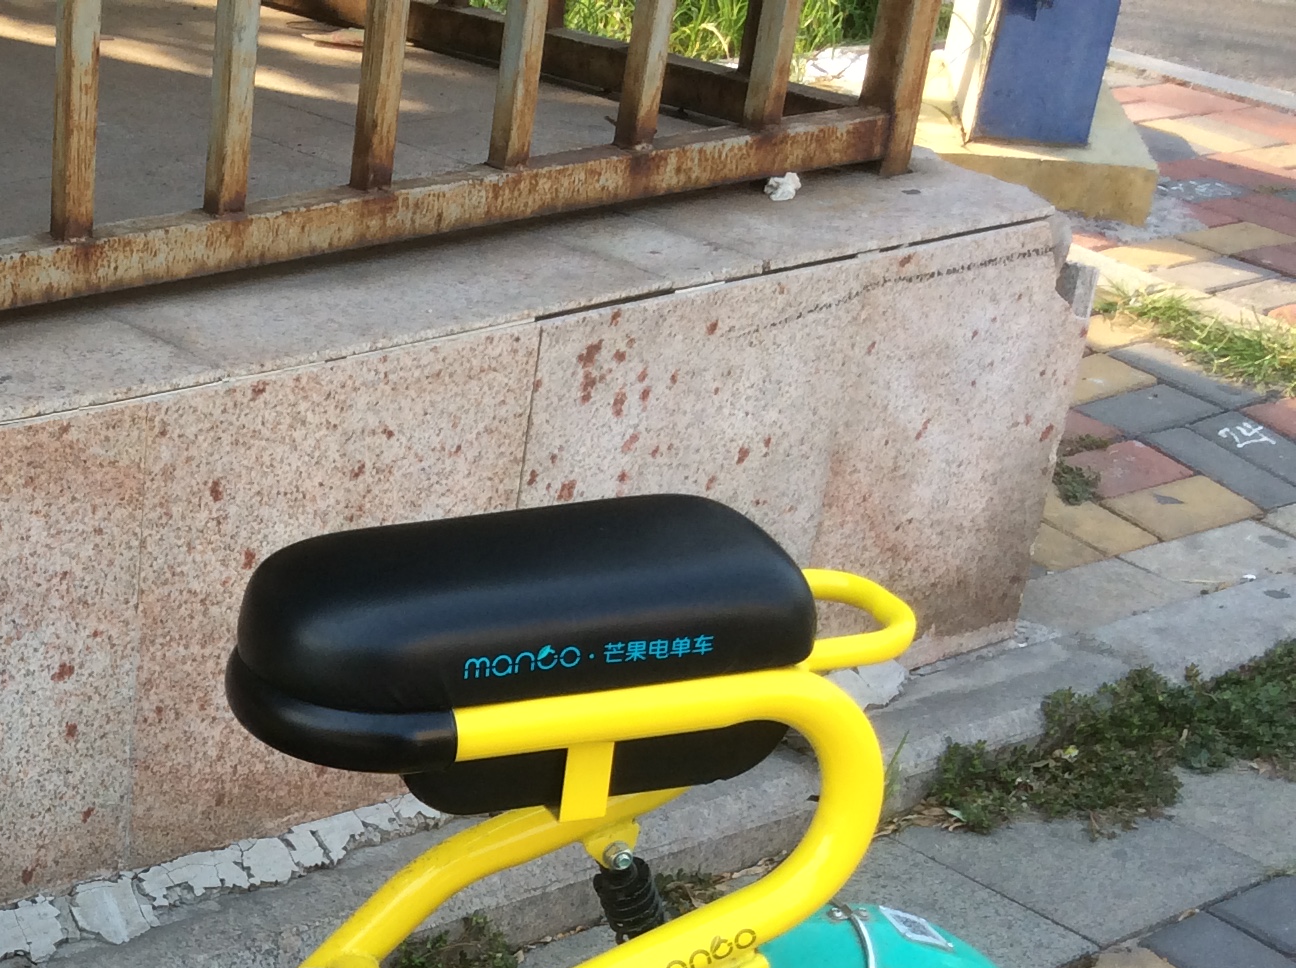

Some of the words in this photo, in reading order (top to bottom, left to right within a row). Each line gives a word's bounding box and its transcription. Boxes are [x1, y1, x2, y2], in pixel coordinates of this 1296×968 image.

[602, 633, 715, 664] 芒果电单车
